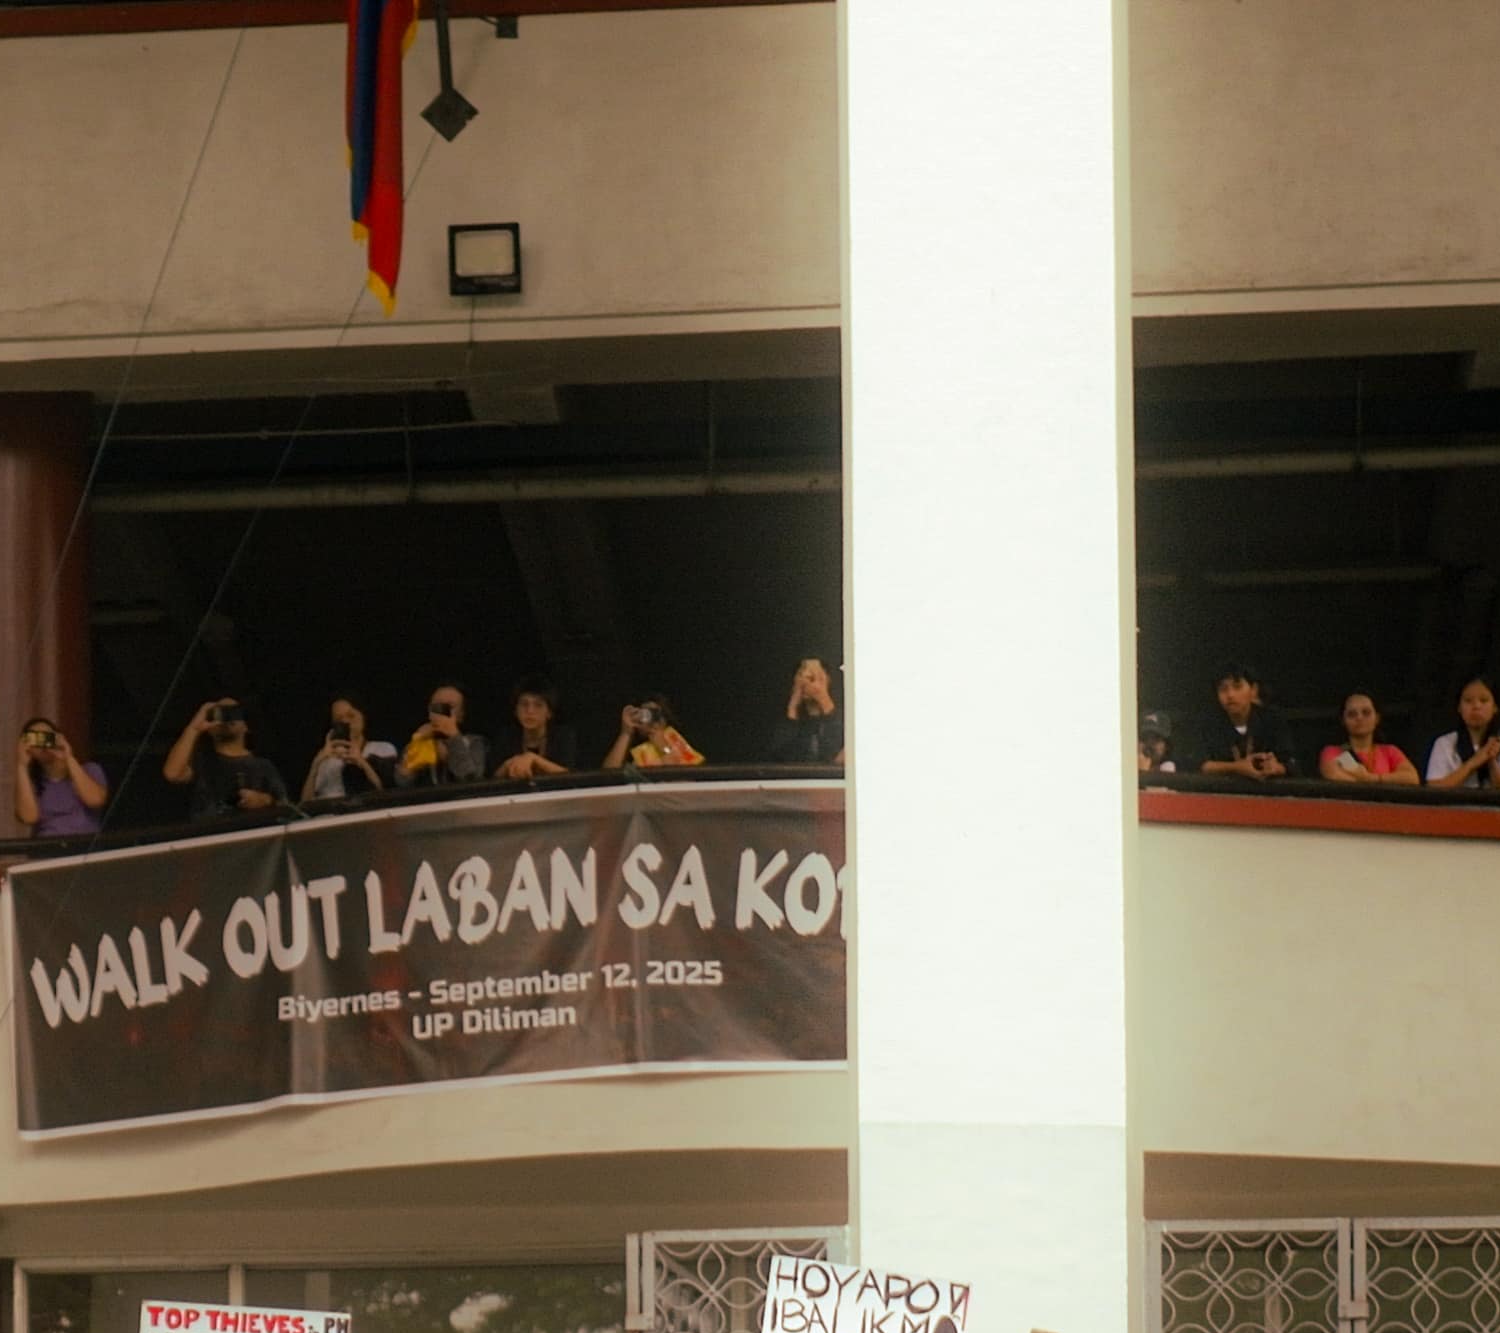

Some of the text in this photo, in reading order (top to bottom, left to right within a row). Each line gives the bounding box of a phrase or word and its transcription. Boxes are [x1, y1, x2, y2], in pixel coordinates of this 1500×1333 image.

[31, 908, 208, 1027] WALK
[223, 876, 347, 978] OUT
[366, 846, 597, 956] LABAN
[618, 844, 716, 931] SA
[278, 988, 401, 1021] Biyernes
[429, 966, 592, 1005] September
[645, 961, 722, 988] 2025
[412, 1004, 576, 1039] UP Diliman
[147, 1307, 200, 1330] TOP
